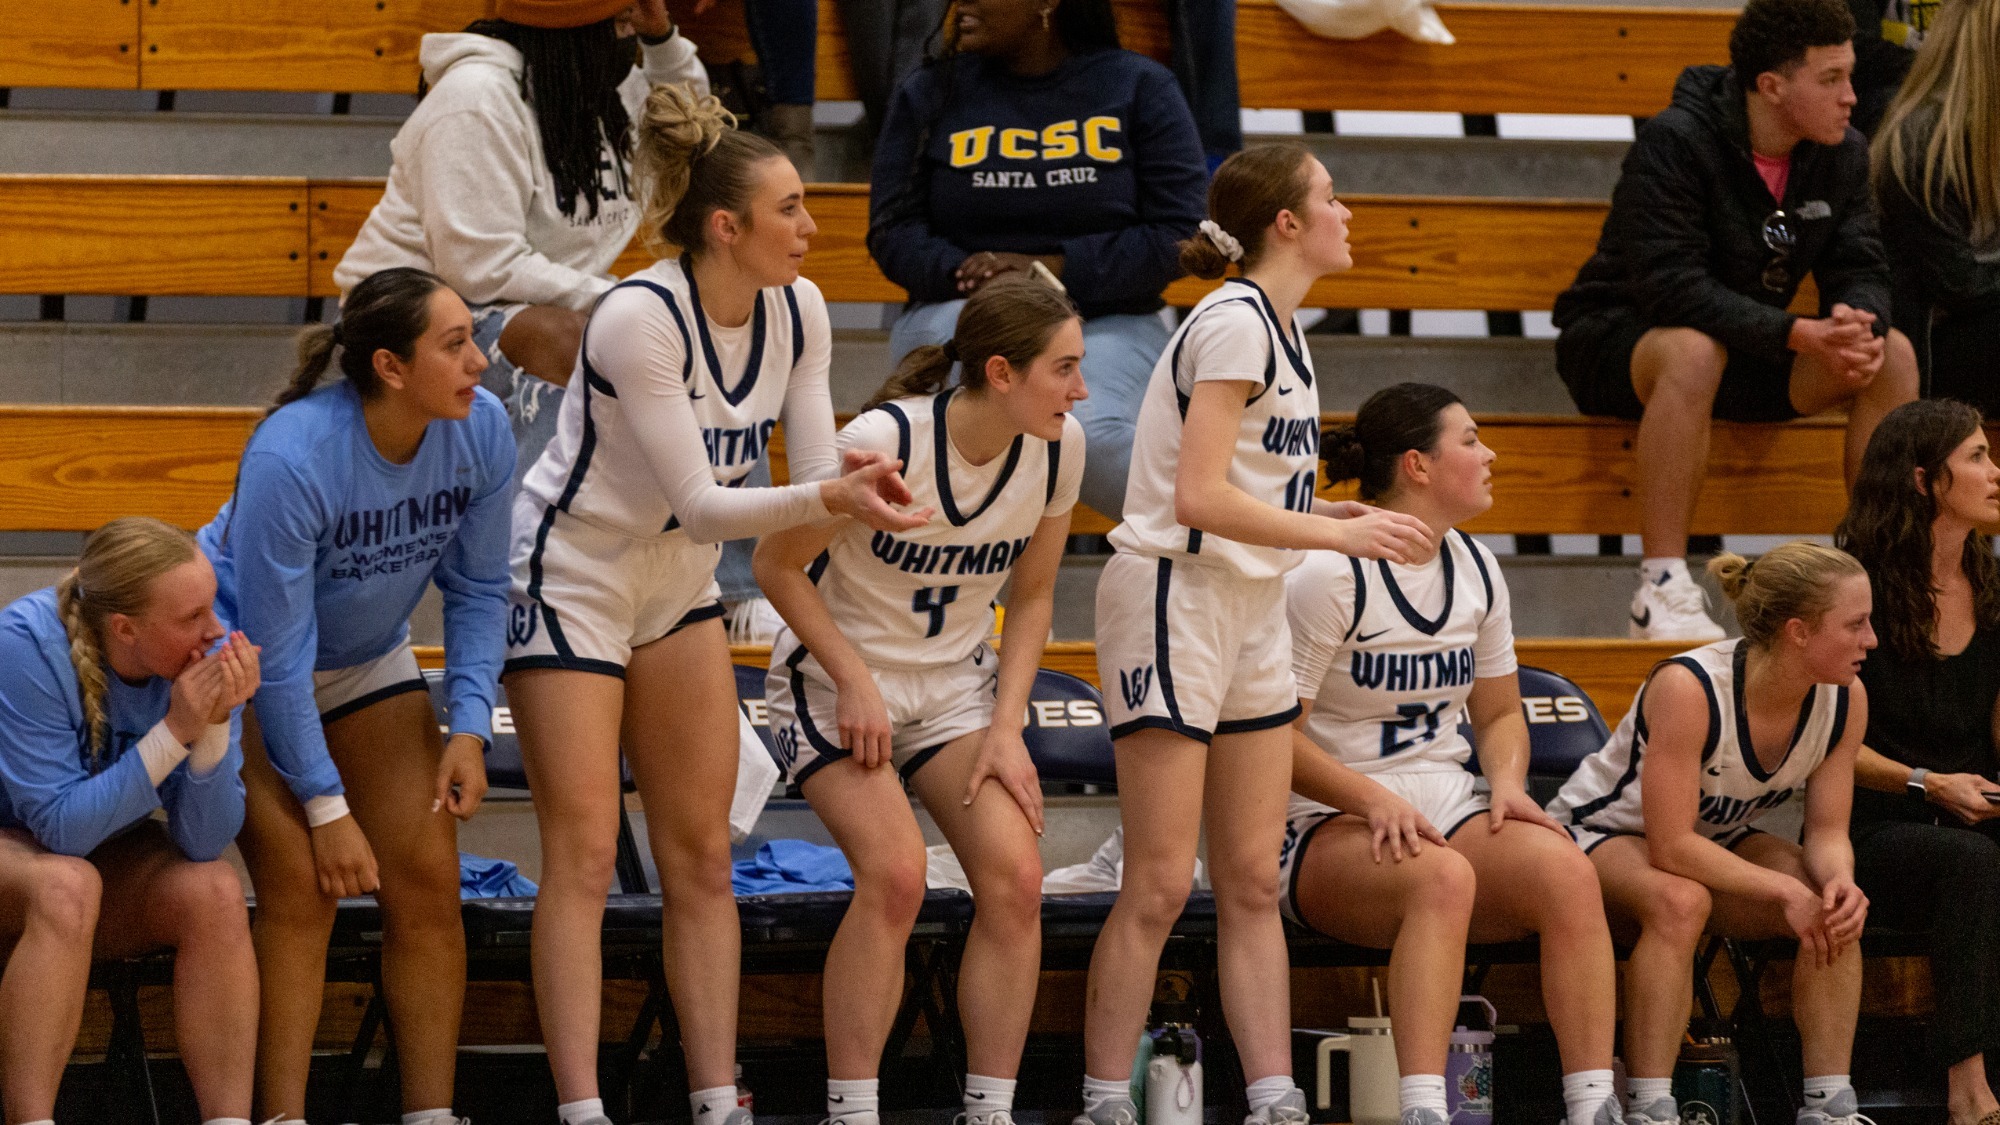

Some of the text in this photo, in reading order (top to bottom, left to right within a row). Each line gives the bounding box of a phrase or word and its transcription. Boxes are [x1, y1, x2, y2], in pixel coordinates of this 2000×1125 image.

[950, 116, 1123, 168] UCSC
[972, 167, 1098, 188] SANTA CRUZ
[331, 548, 440, 582] BASKETBA
[911, 585, 960, 639] 4
[1351, 646, 1476, 691] WHITMA
